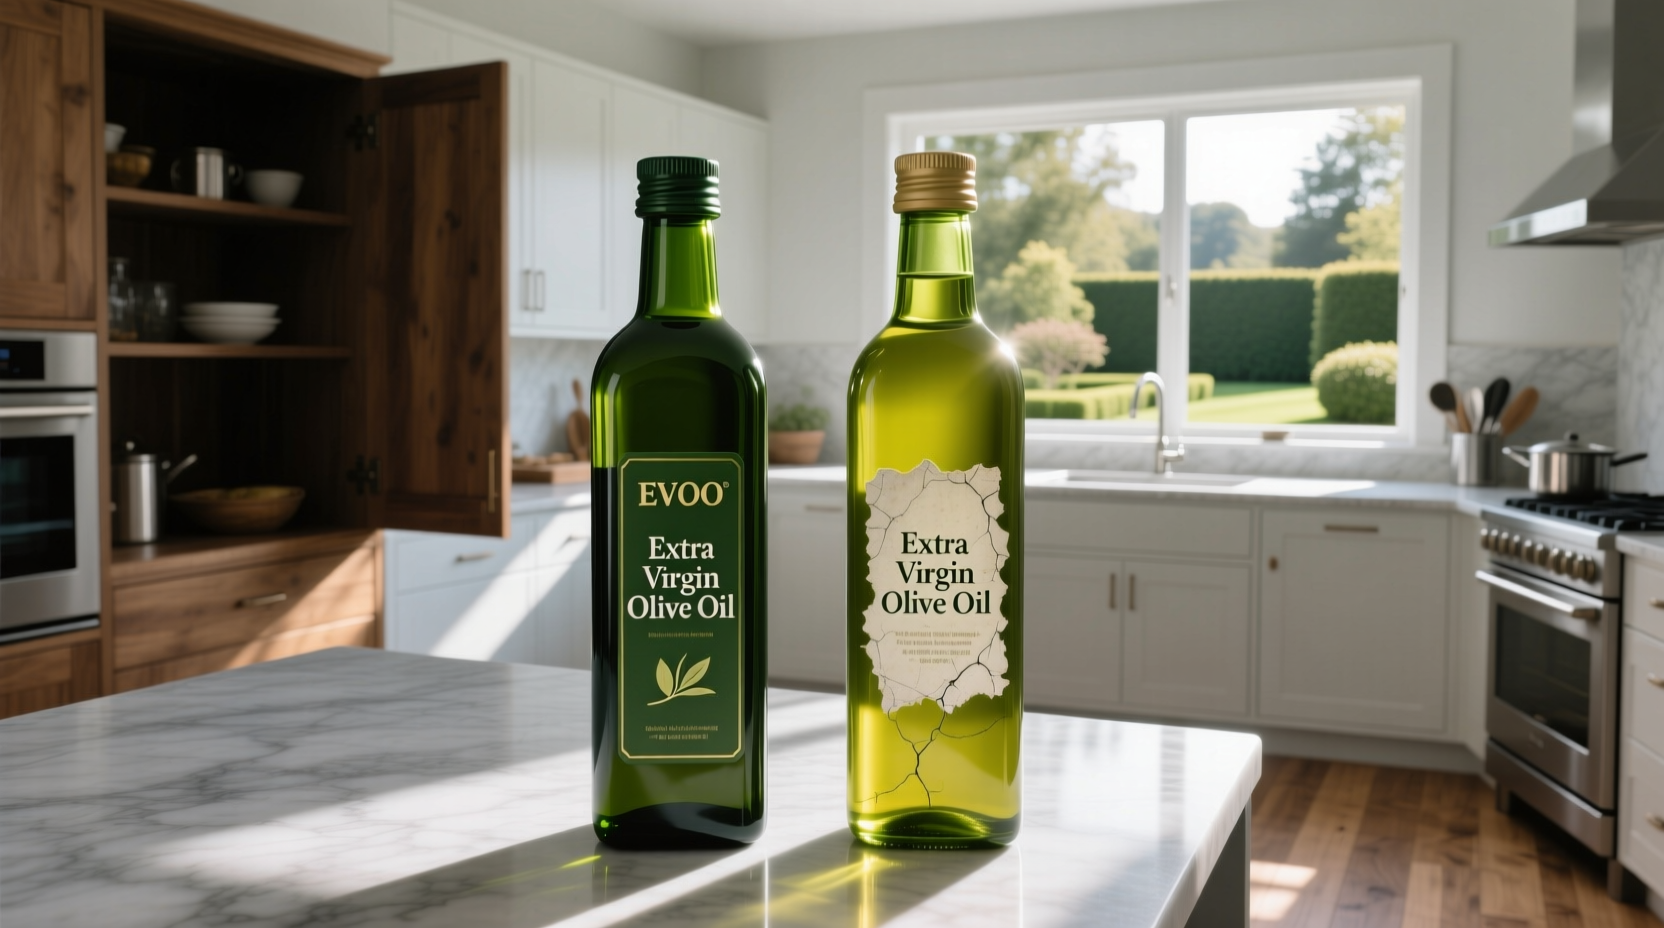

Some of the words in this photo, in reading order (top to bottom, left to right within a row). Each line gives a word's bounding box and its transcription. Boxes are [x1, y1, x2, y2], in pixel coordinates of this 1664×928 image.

[648, 536, 715, 560] Extra
[901, 531, 969, 555] Extra
[642, 566, 720, 596] Virgin
[896, 560, 975, 591] Virgin
[627, 595, 692, 619] Olive
[697, 594, 735, 619] Oil
[881, 590, 946, 614] Olive
[952, 590, 991, 614] Oil
